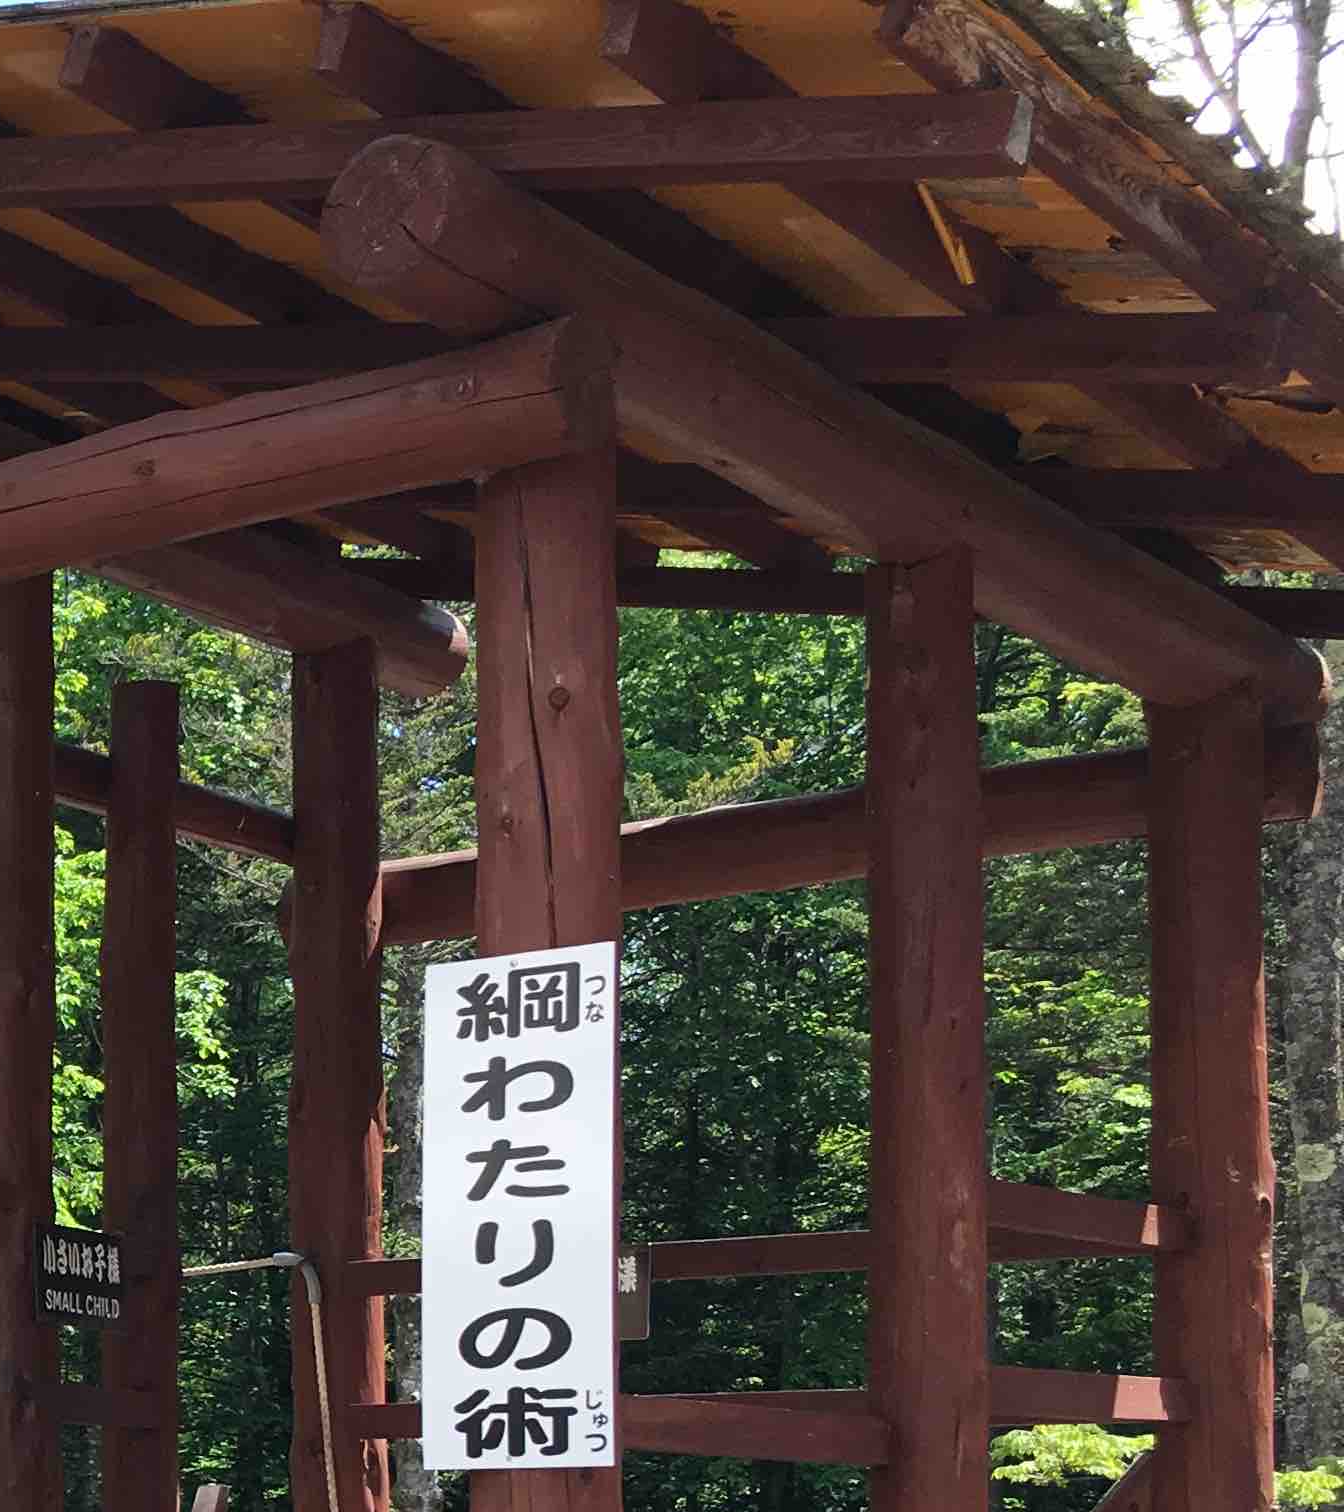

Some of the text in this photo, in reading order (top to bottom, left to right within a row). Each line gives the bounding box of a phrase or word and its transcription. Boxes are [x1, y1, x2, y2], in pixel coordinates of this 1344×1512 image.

[584, 975, 607, 1023] つな
[454, 961, 582, 1459] 綱わたりの術
[45, 1289, 120, 1320] SMALL CHILD
[584, 1389, 609, 1452] じゅつ
